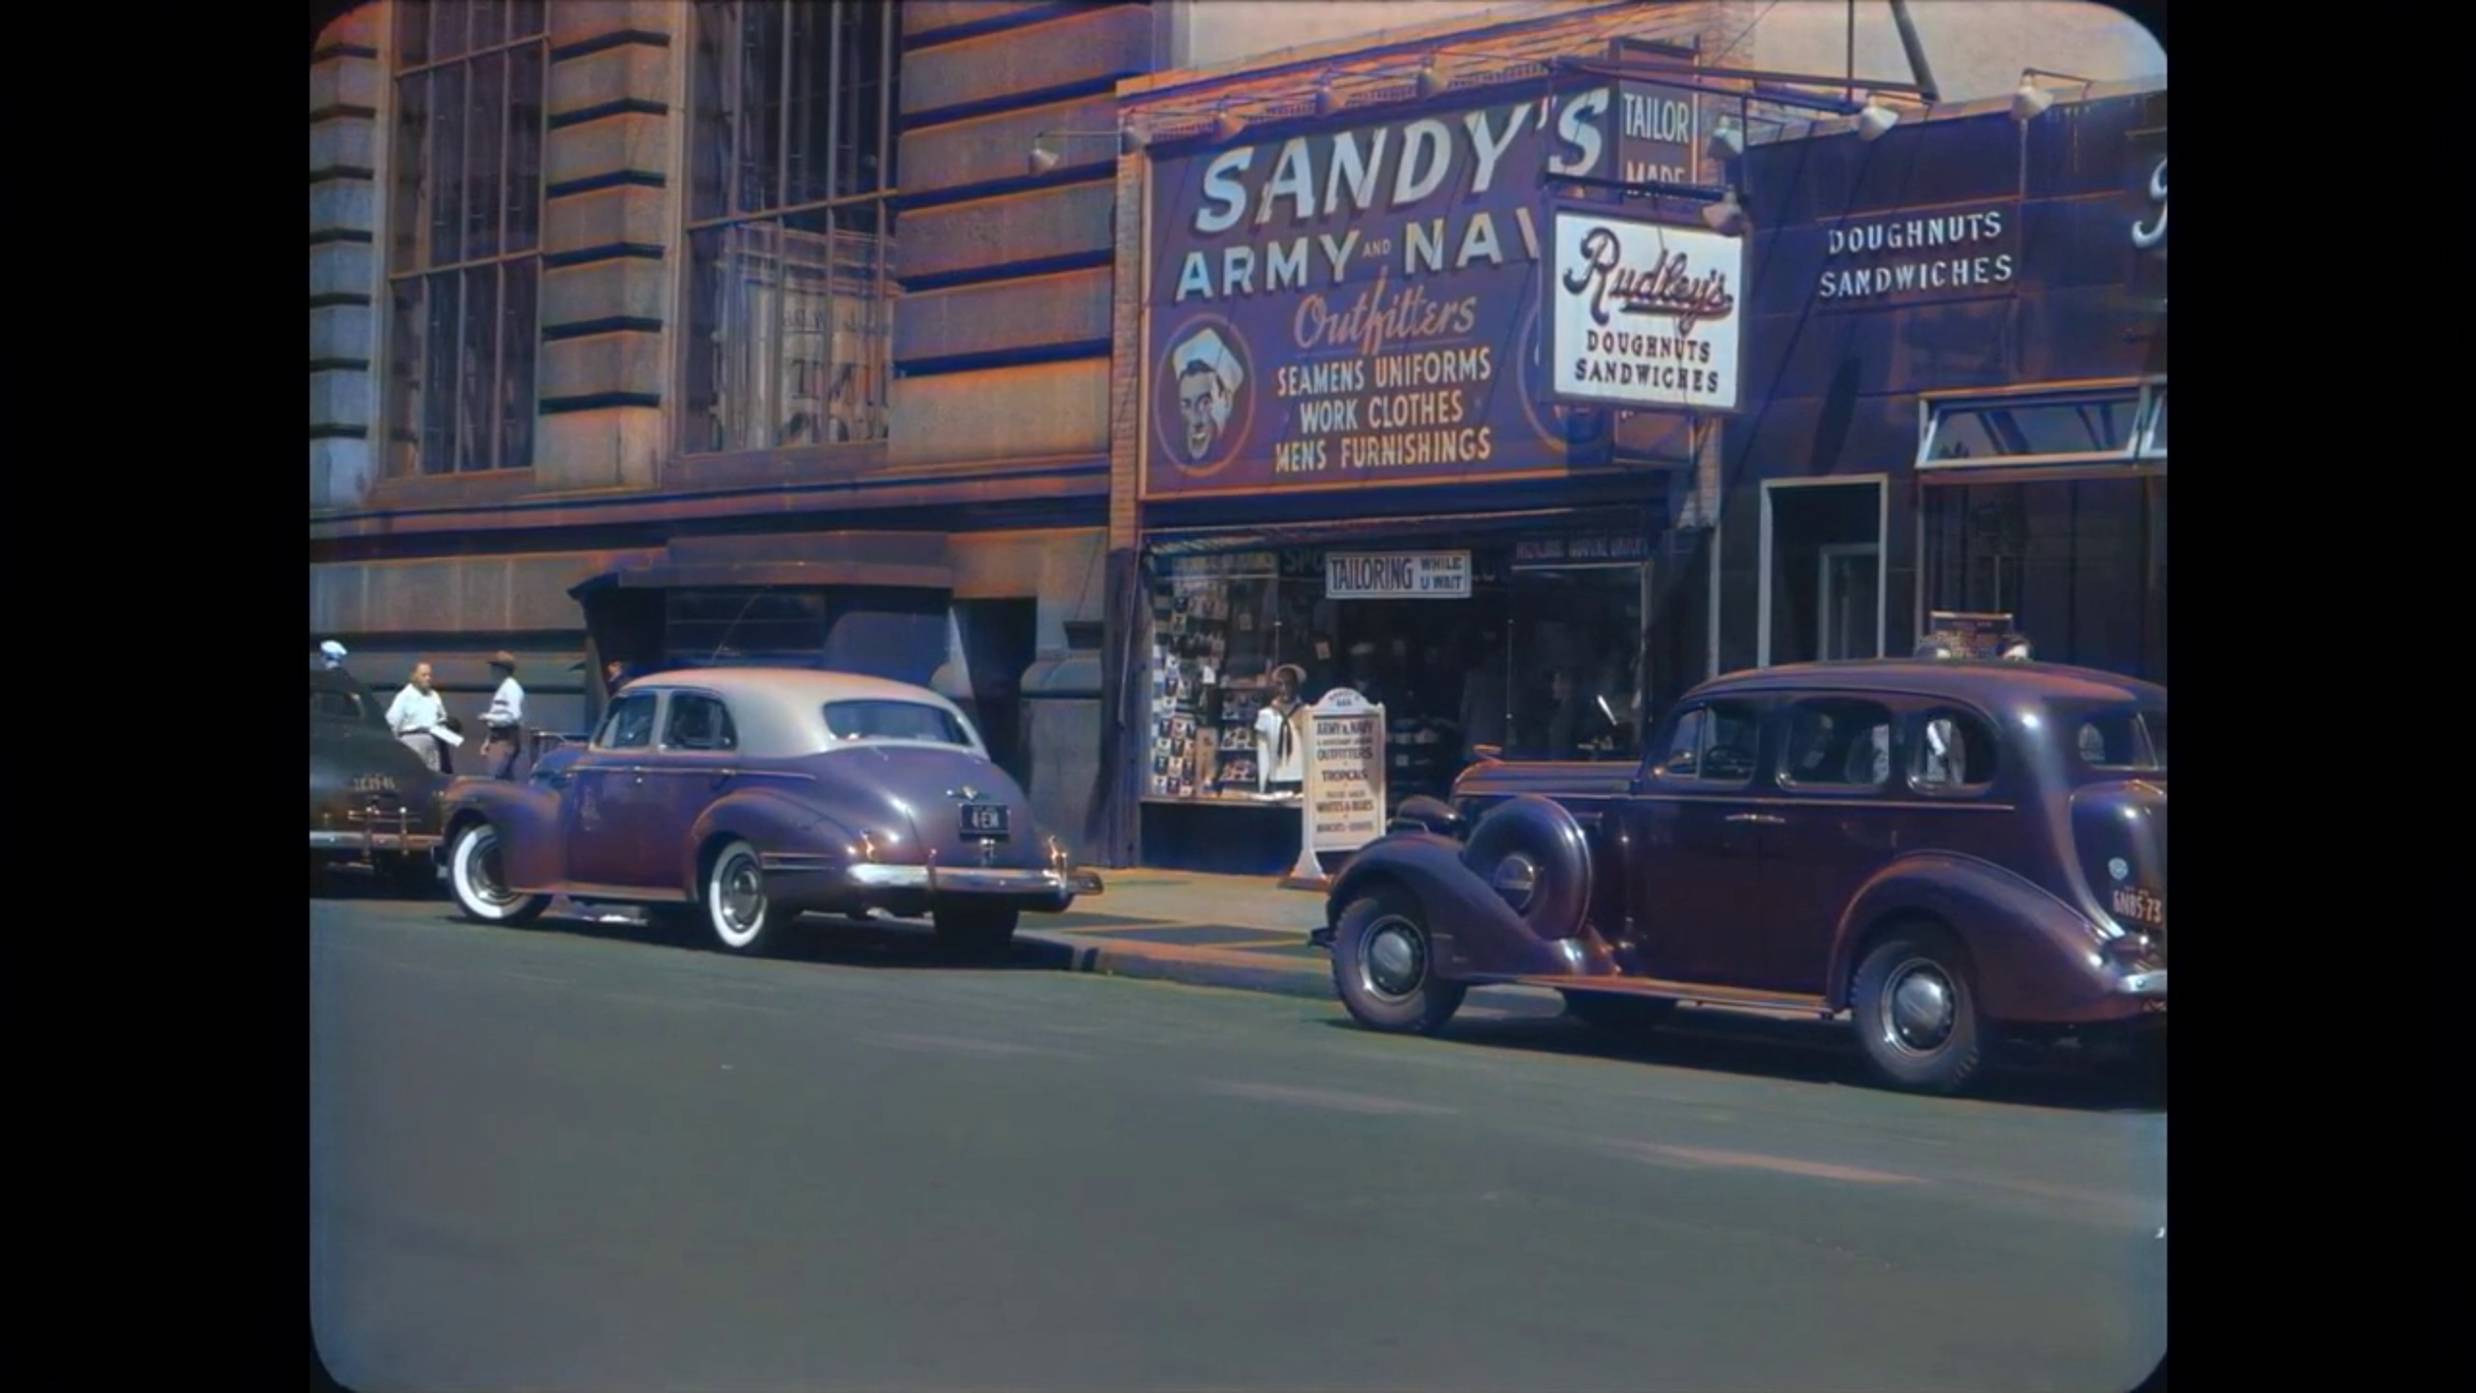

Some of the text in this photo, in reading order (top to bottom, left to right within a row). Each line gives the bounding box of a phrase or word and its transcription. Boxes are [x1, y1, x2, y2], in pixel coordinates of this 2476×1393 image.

[1624, 92, 1689, 144] TAILOR
[1195, 87, 1610, 233] SANDY'S
[1829, 211, 2001, 254] DOUGHNUTS
[1176, 230, 1360, 301] ARMY
[1362, 239, 1392, 257] AND
[1563, 226, 1734, 336] Rudley's
[1819, 254, 2012, 297] SANDWICHES
[1294, 265, 1477, 355] Outfitters
[1587, 330, 1711, 363] DOUGHNUTS
[1277, 347, 1491, 396] SEAMENS UNIFORMS
[1575, 358, 1718, 393] SANDWICHES
[1300, 390, 1463, 434] WORK CLOTHES
[1275, 427, 1491, 473] MENS FURNISHINGS
[1332, 557, 1413, 590] TAILORING
[1420, 557, 1461, 571] WHILE
[1420, 575, 1462, 589] U WAIT
[1316, 722, 1340, 735] ARMY
[1316, 747, 1373, 761] OUTFITTERS
